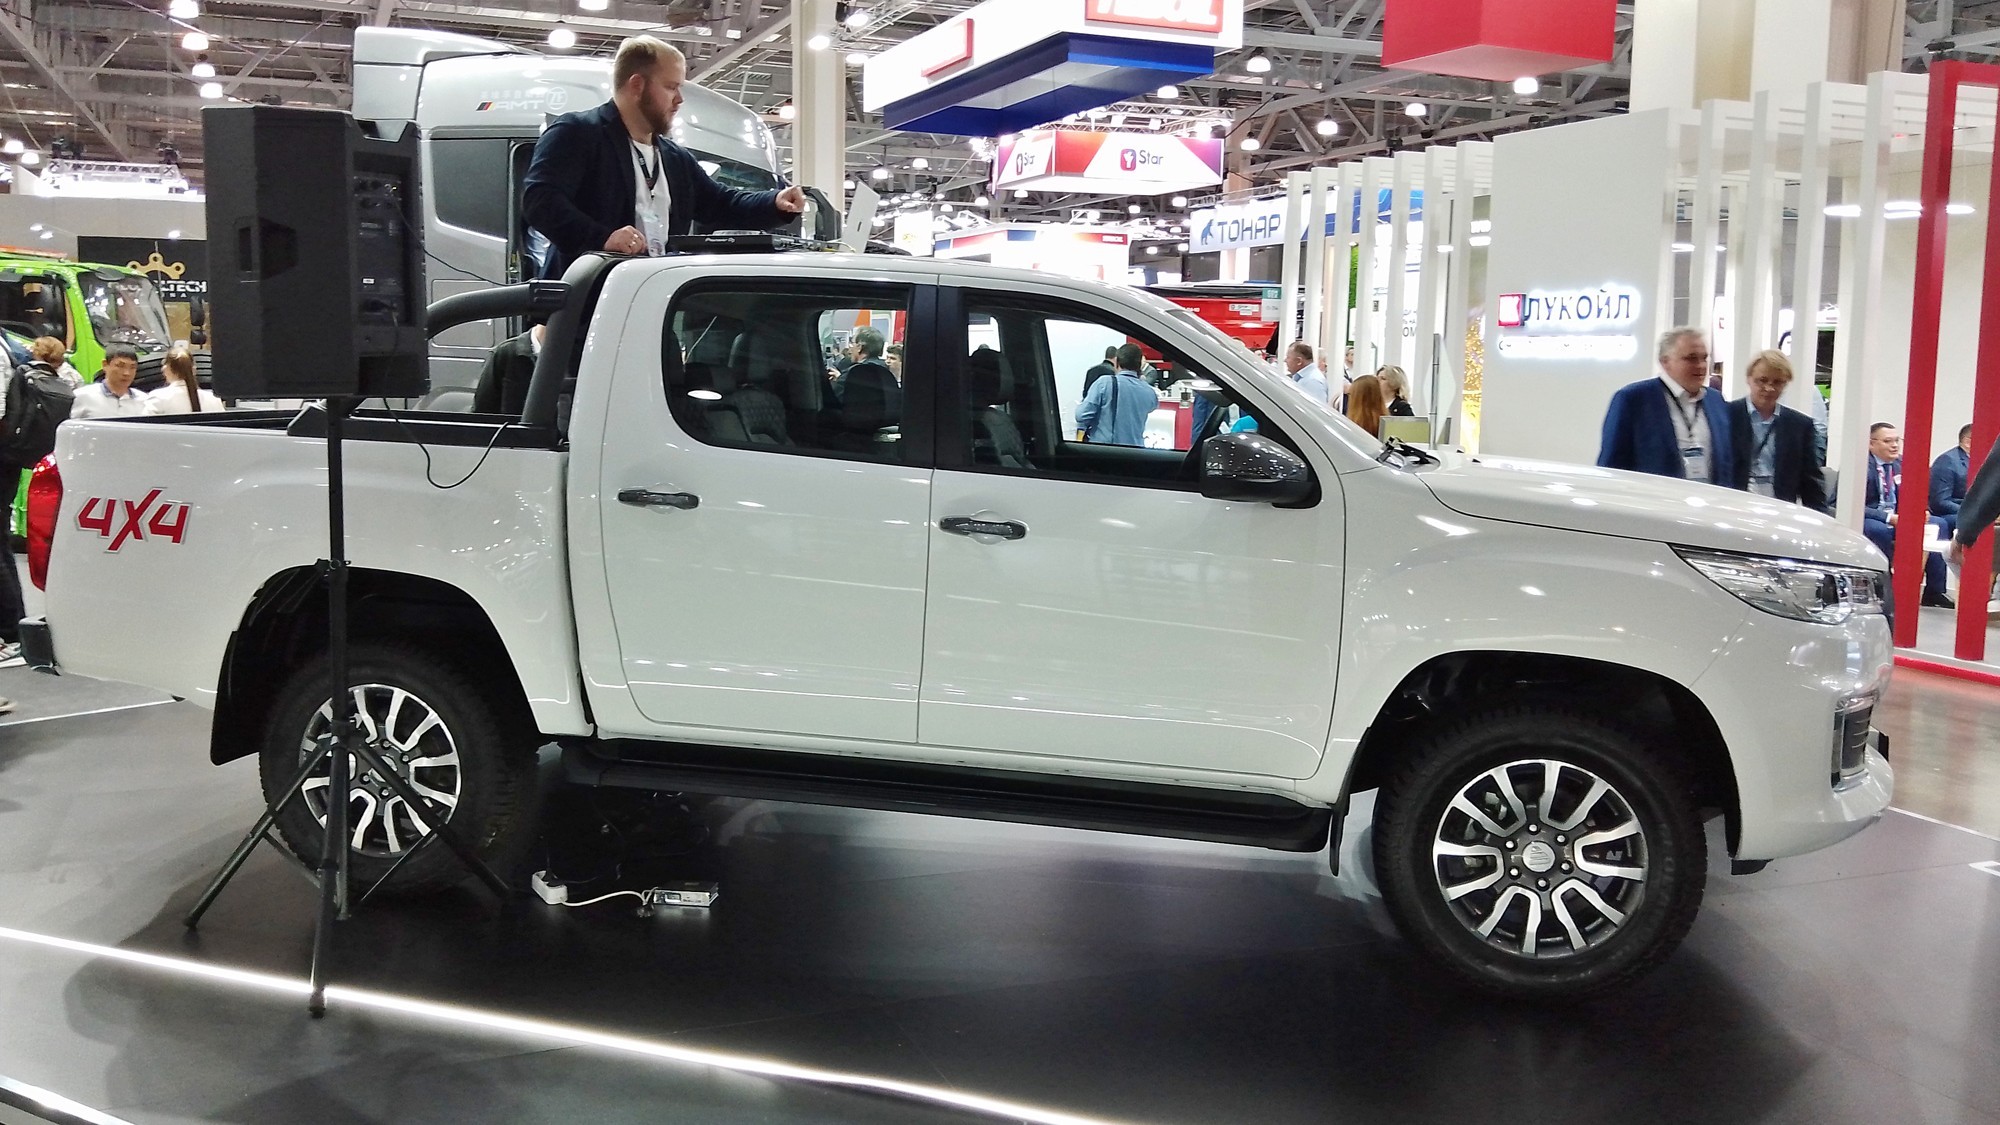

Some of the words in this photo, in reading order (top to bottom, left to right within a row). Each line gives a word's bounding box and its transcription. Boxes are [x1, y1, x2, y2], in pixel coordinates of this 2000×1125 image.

[495, 101, 545, 110] AMT
[1139, 150, 1164, 165] Star
[1217, 213, 1281, 243] ТОНАР
[1524, 288, 1630, 321] ЛУКОЙЛ
